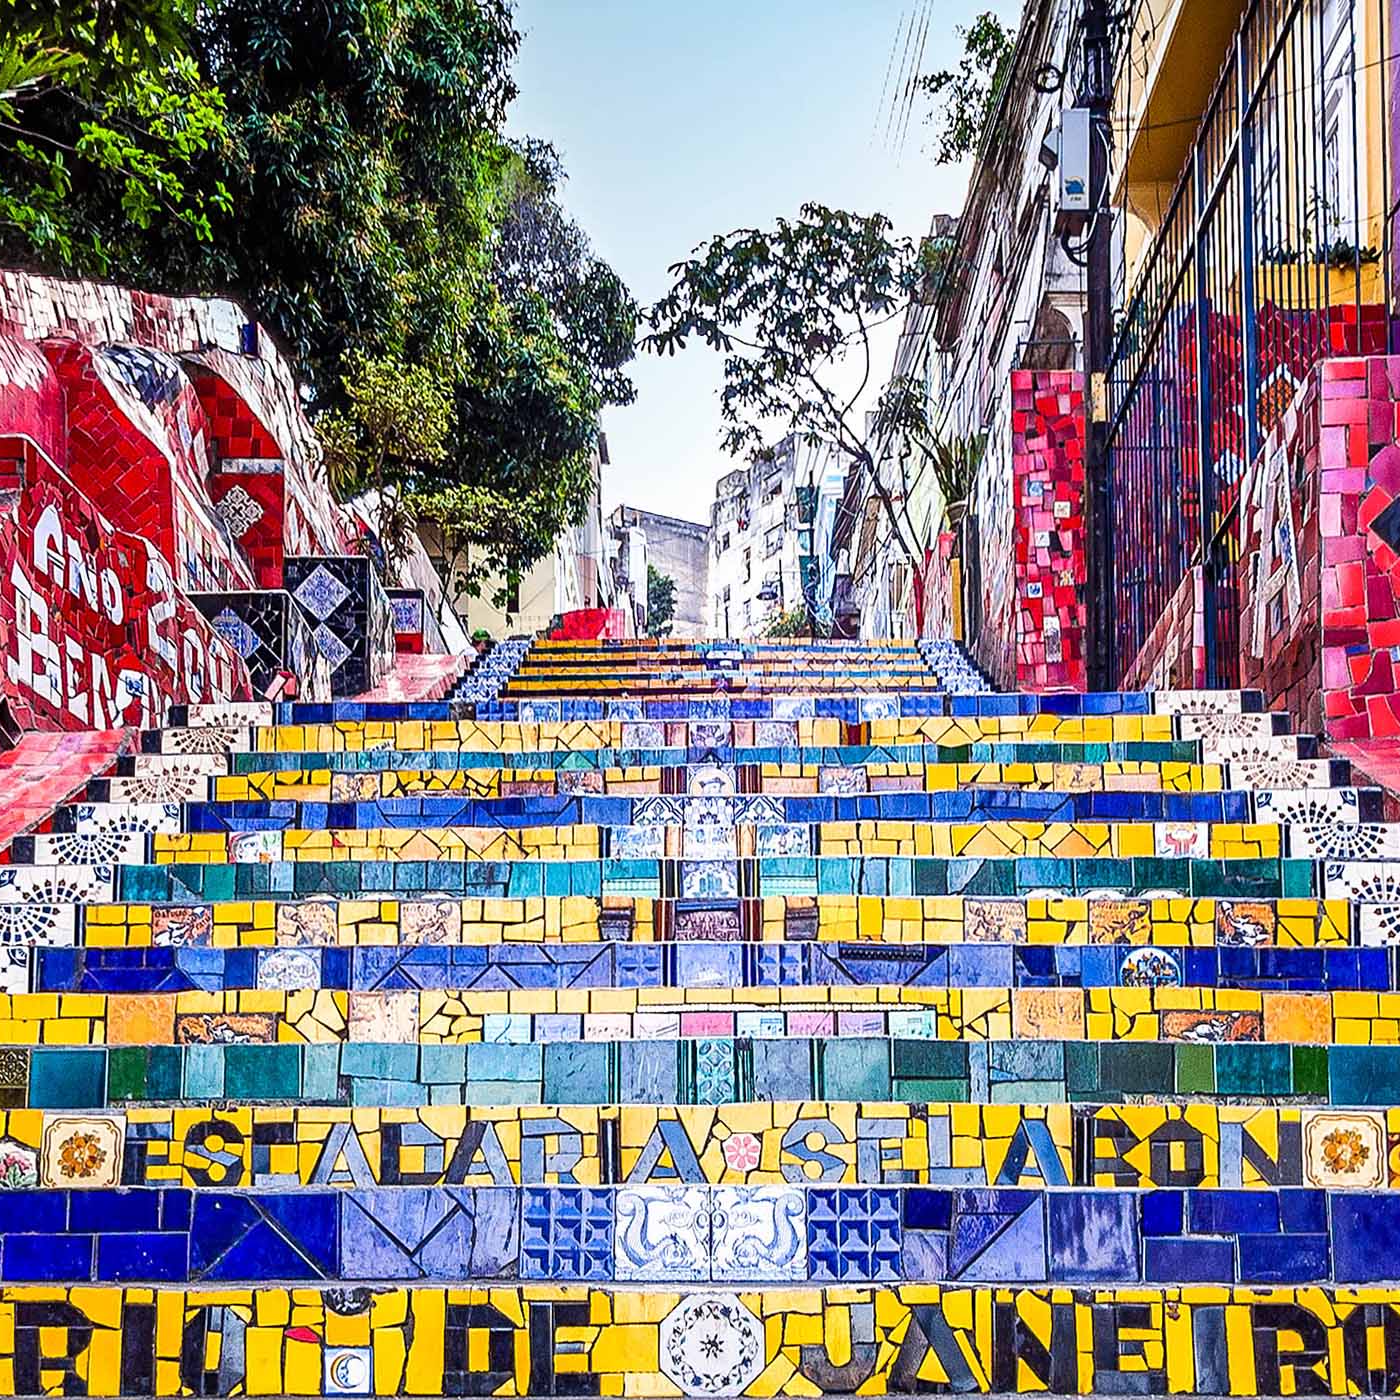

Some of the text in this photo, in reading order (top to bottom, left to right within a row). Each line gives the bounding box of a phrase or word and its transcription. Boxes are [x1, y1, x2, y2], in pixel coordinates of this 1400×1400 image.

[125, 1119, 709, 1186] ESCADARIA
[14, 1301, 249, 1398] RIO
[444, 1303, 604, 1398] DE
